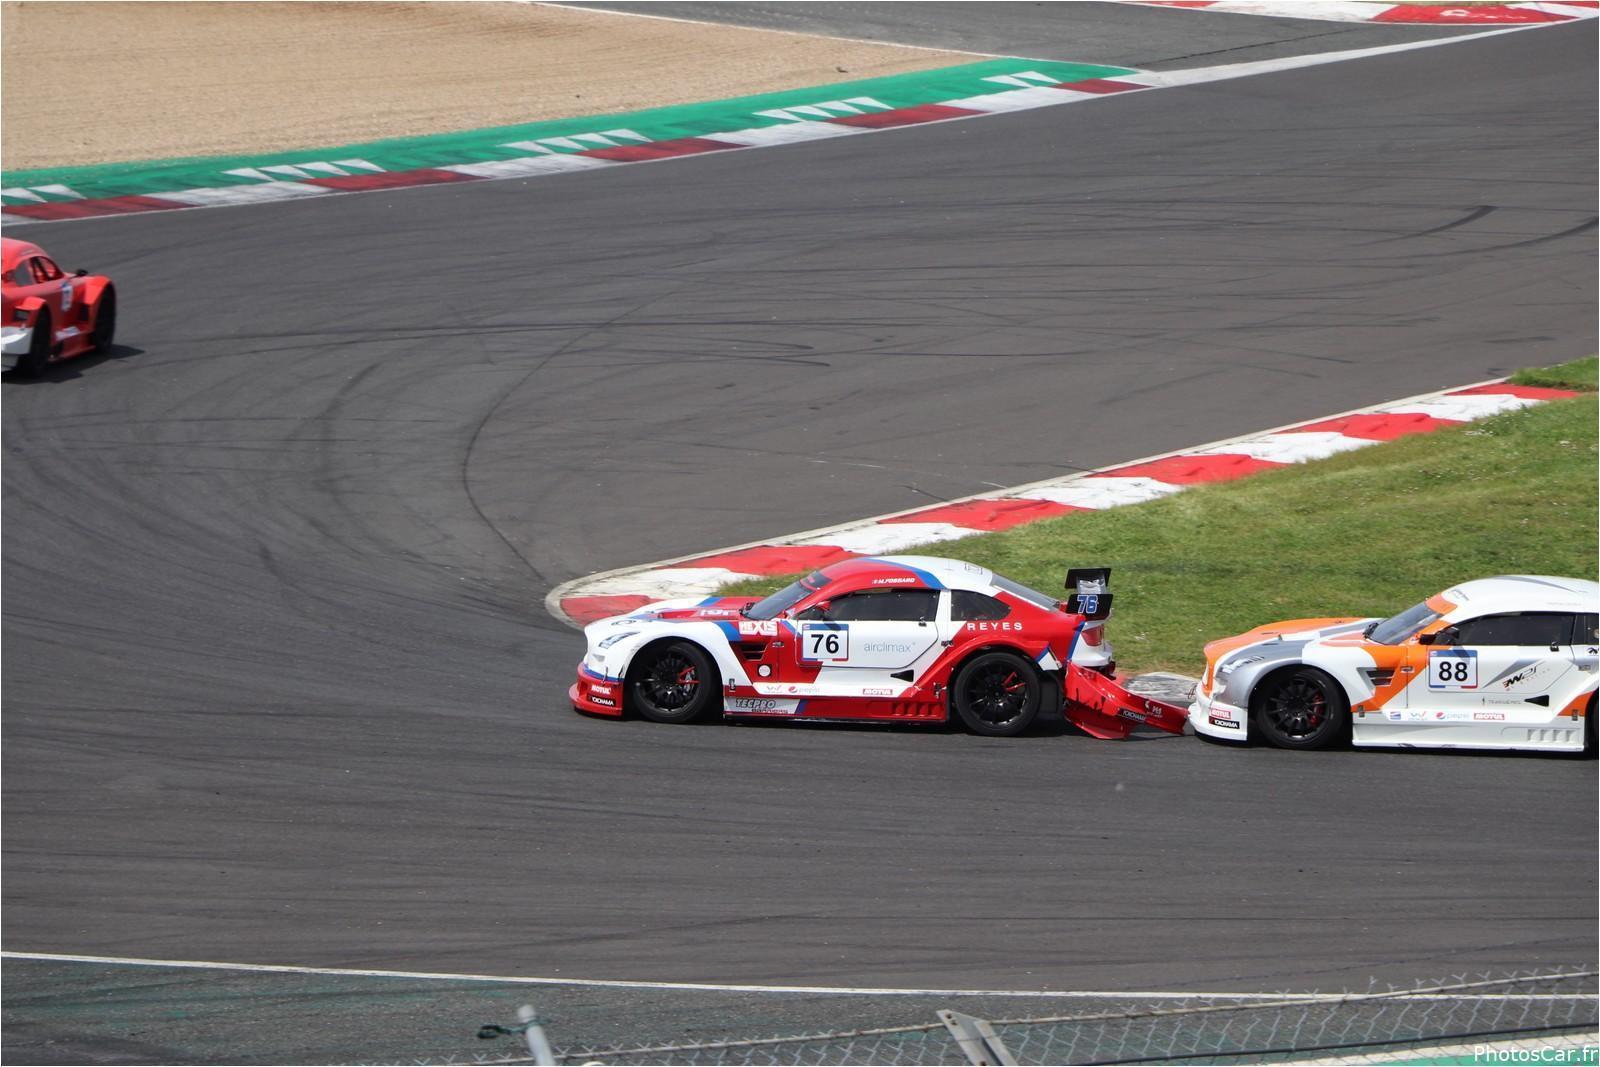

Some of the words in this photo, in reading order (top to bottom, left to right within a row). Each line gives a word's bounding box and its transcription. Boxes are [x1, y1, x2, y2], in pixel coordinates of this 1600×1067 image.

[1077, 594, 1099, 614] 76
[966, 622, 1023, 631] REYES
[810, 633, 840, 654] 76
[863, 642, 912, 653] airclimax
[1438, 661, 1468, 682] 88
[591, 684, 612, 695] MOTUL
[736, 698, 776, 709] TECPRO
